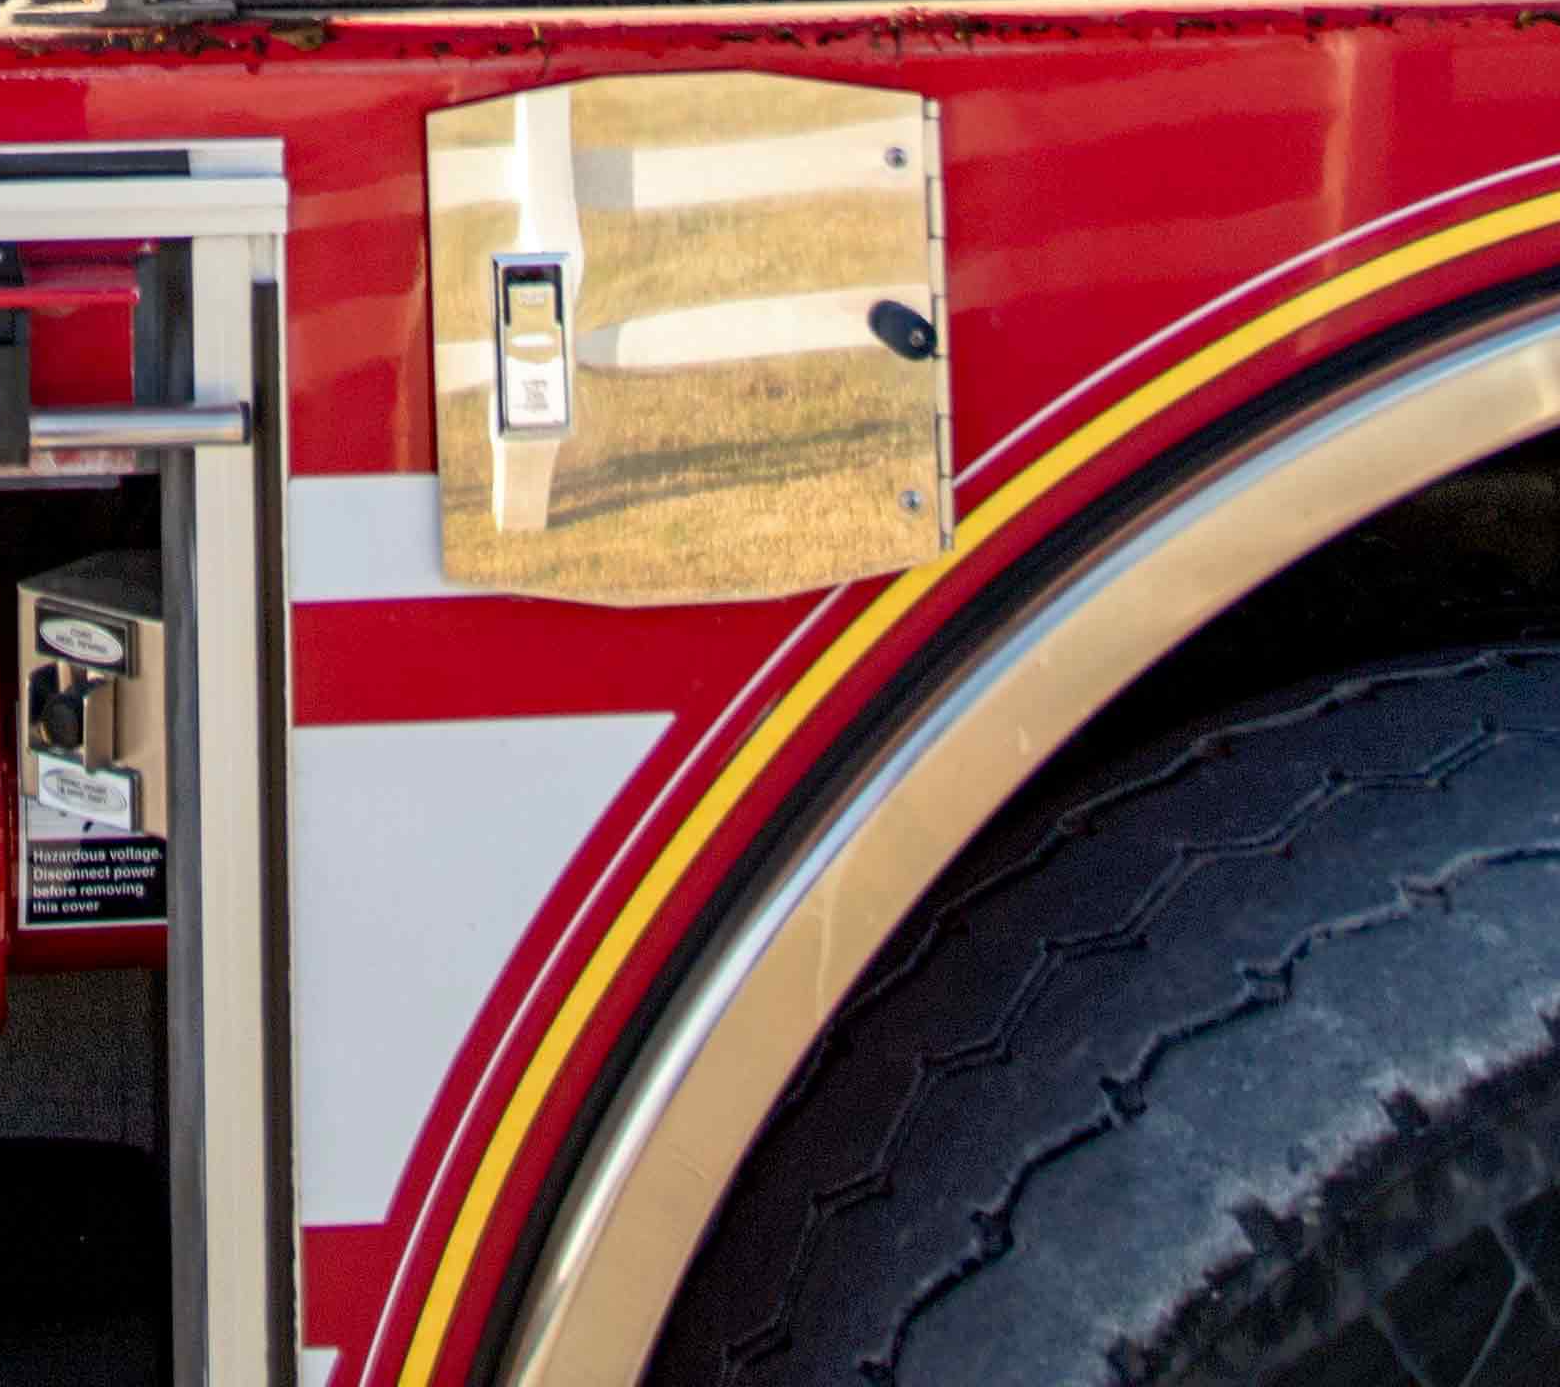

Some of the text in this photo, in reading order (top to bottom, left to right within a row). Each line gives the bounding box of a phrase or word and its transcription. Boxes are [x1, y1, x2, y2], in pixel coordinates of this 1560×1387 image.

[32, 847, 107, 863] Hazardous
[32, 865, 157, 882] Disconnect power
[32, 882, 145, 898] before removing
[32, 900, 101, 914] this cover
